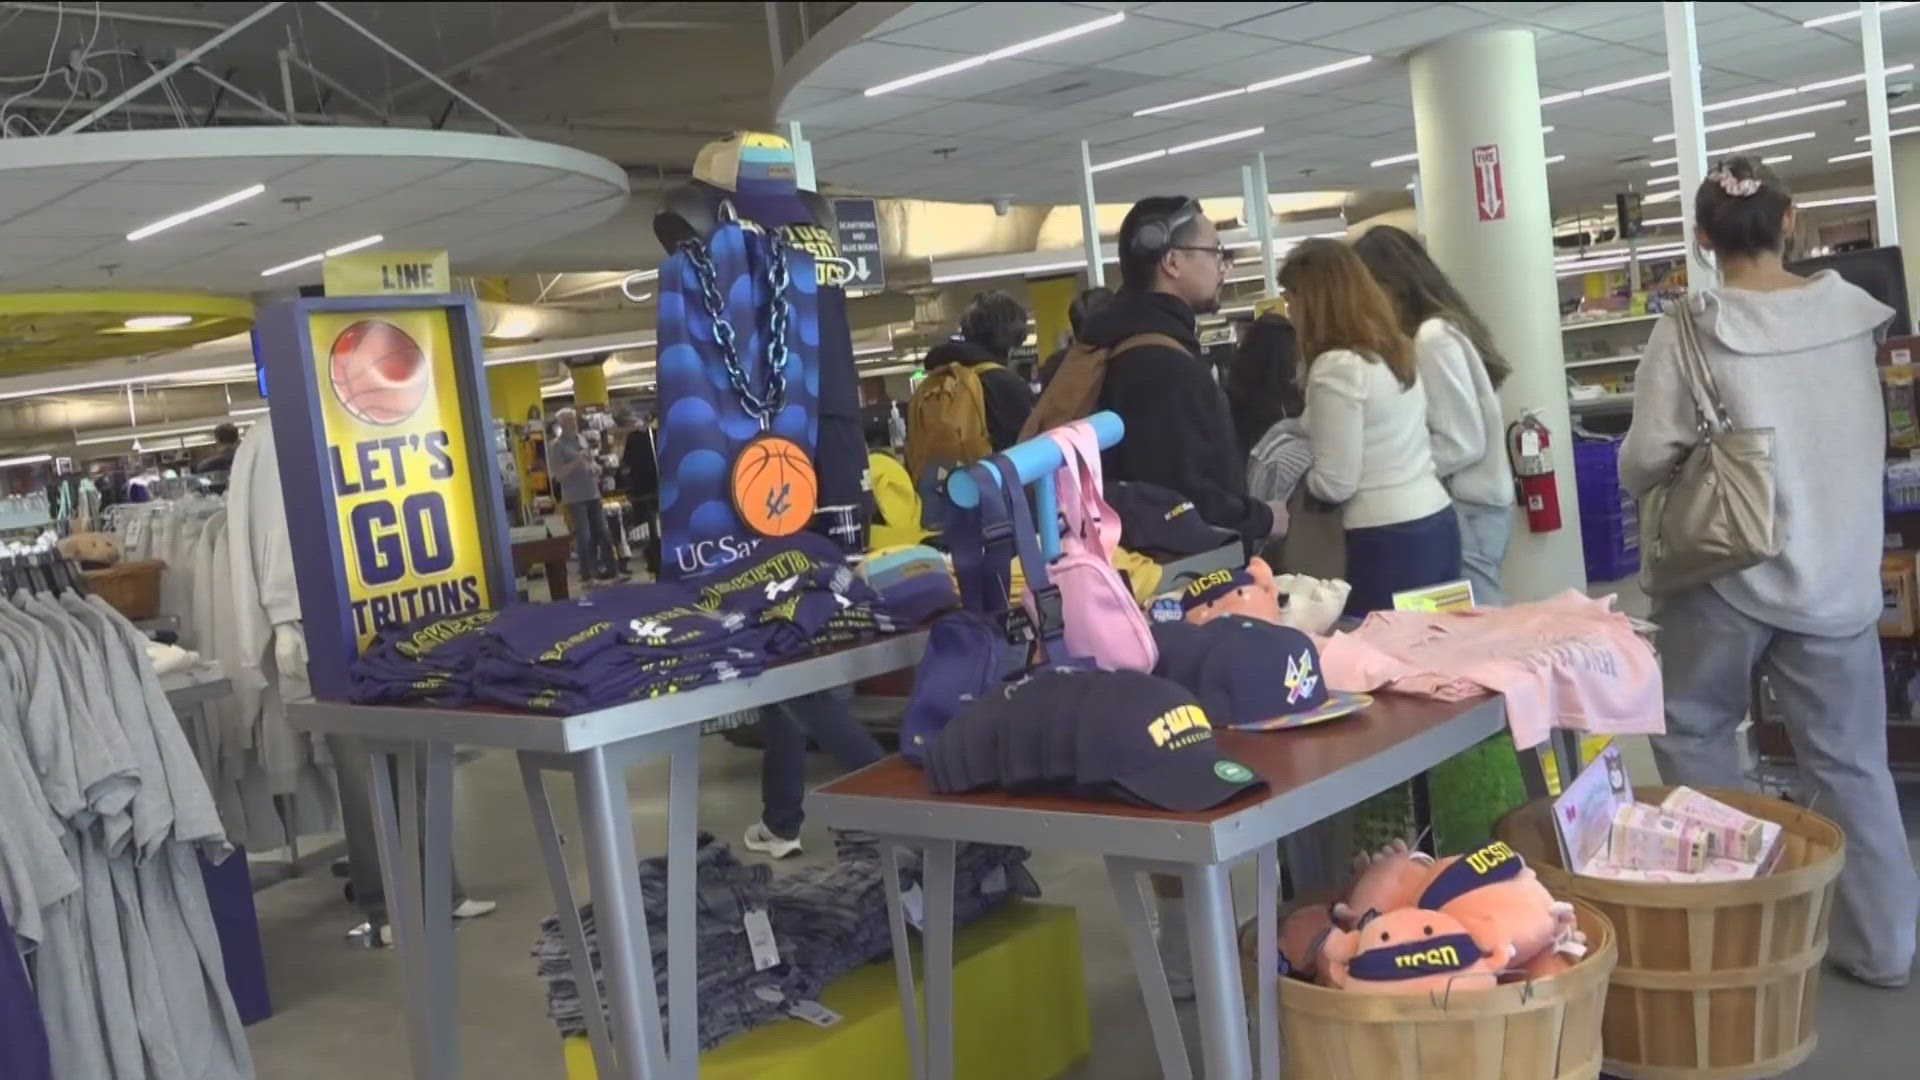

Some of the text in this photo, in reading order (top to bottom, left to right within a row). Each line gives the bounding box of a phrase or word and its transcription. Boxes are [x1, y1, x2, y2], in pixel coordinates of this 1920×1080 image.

[381, 264, 434, 289] LINE
[329, 431, 455, 497] LET'S
[351, 491, 456, 587] GO
[351, 575, 482, 636] TRITONS
[1188, 568, 1233, 597] UCSD
[1466, 840, 1515, 875] UCSD
